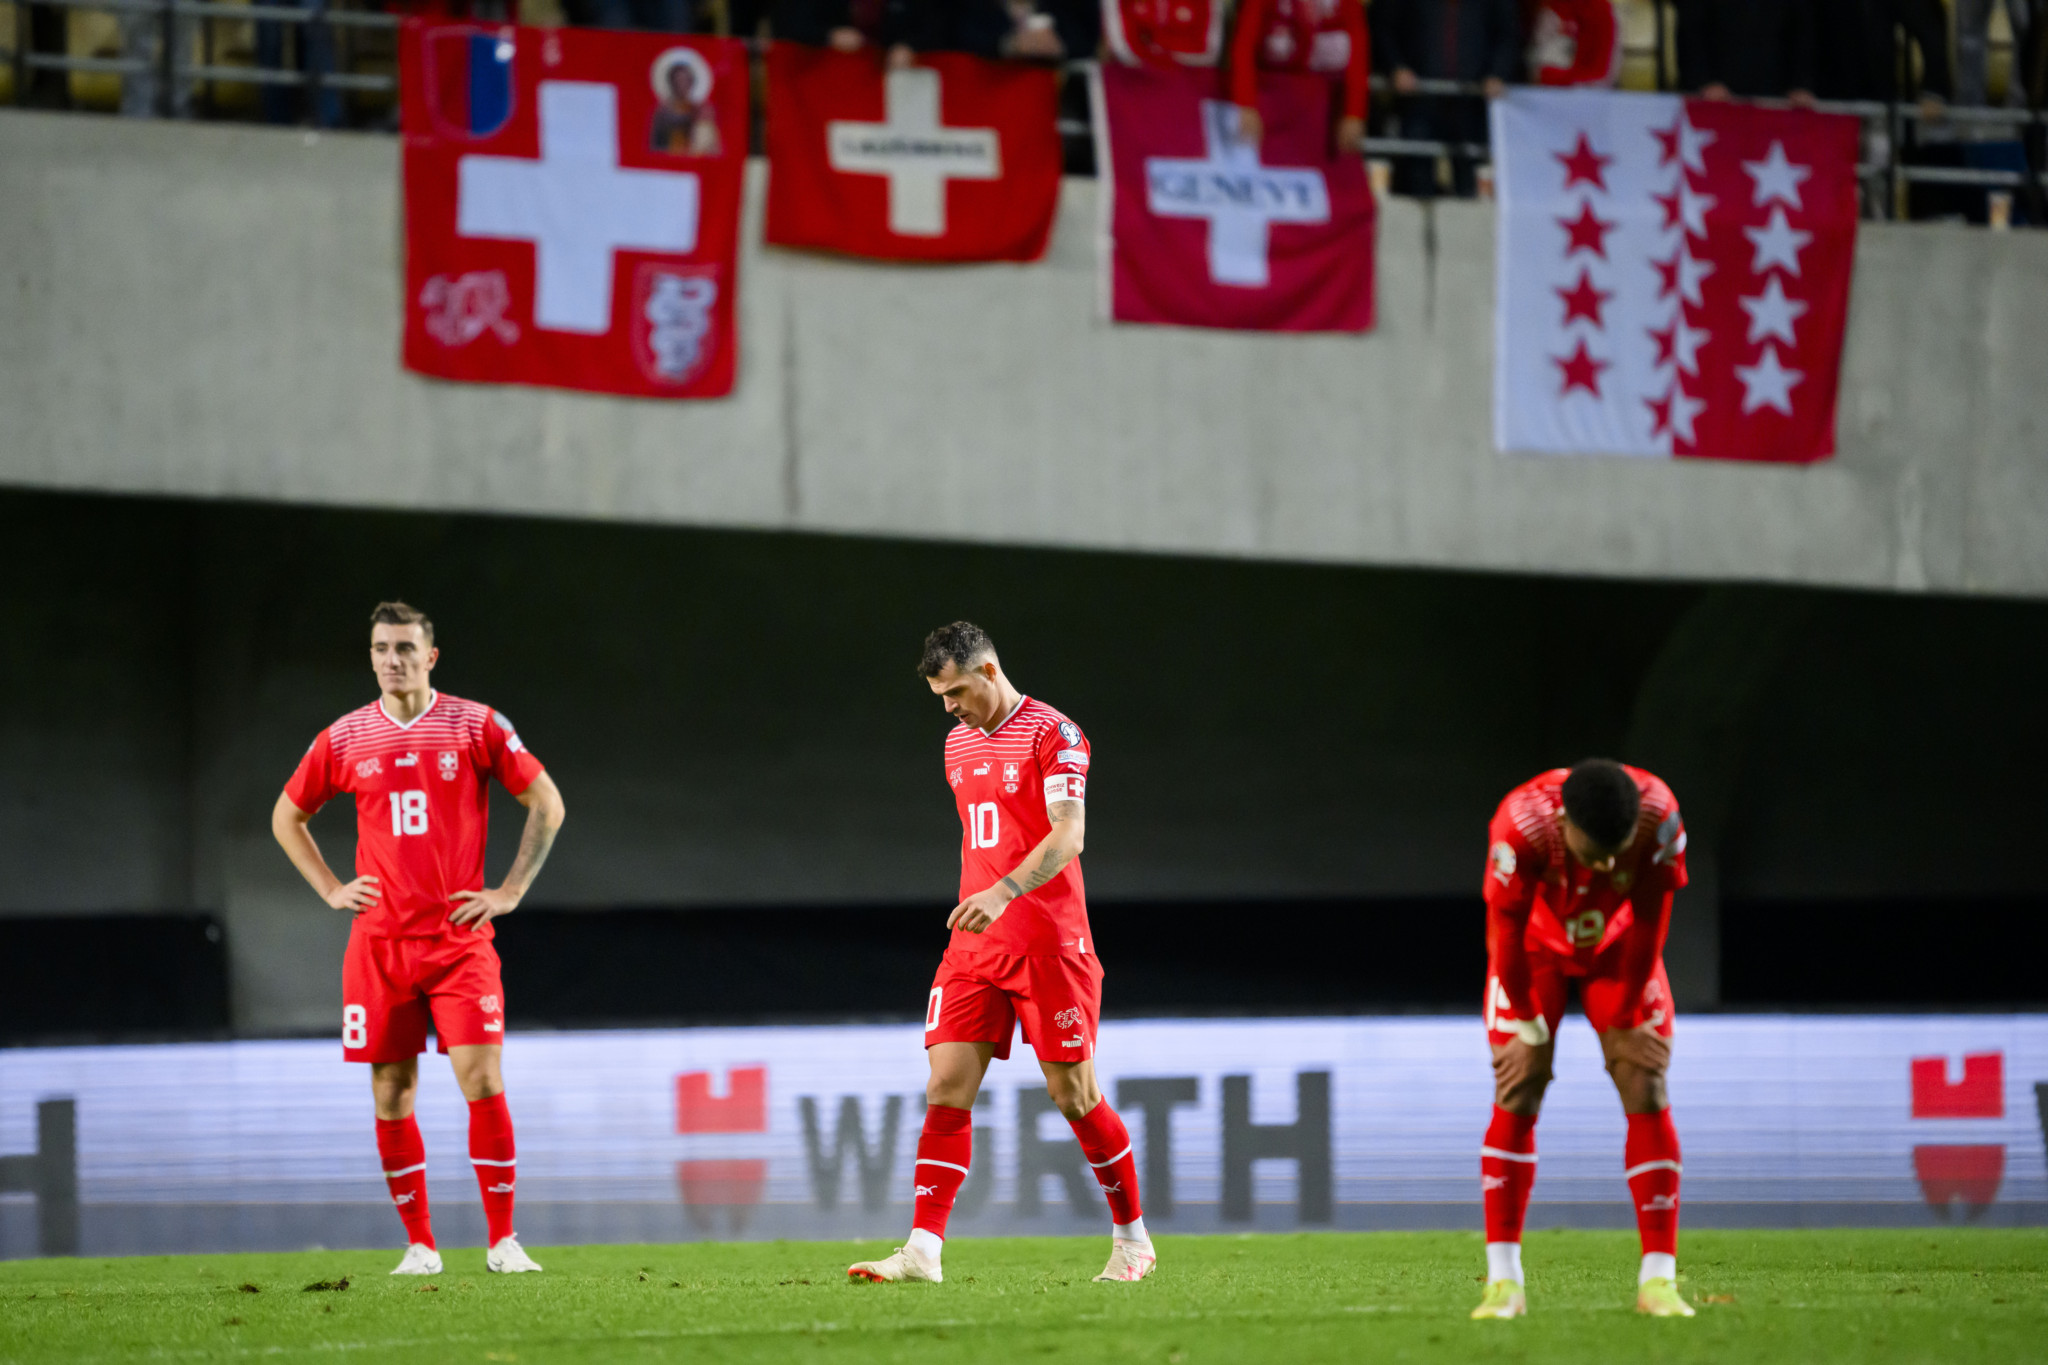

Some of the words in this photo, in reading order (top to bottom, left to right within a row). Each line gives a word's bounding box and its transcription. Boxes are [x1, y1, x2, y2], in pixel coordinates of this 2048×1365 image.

[389, 789, 429, 837] 18
[968, 801, 1000, 850] 10
[1565, 909, 1606, 949] 19
[342, 1003, 367, 1049] 8
